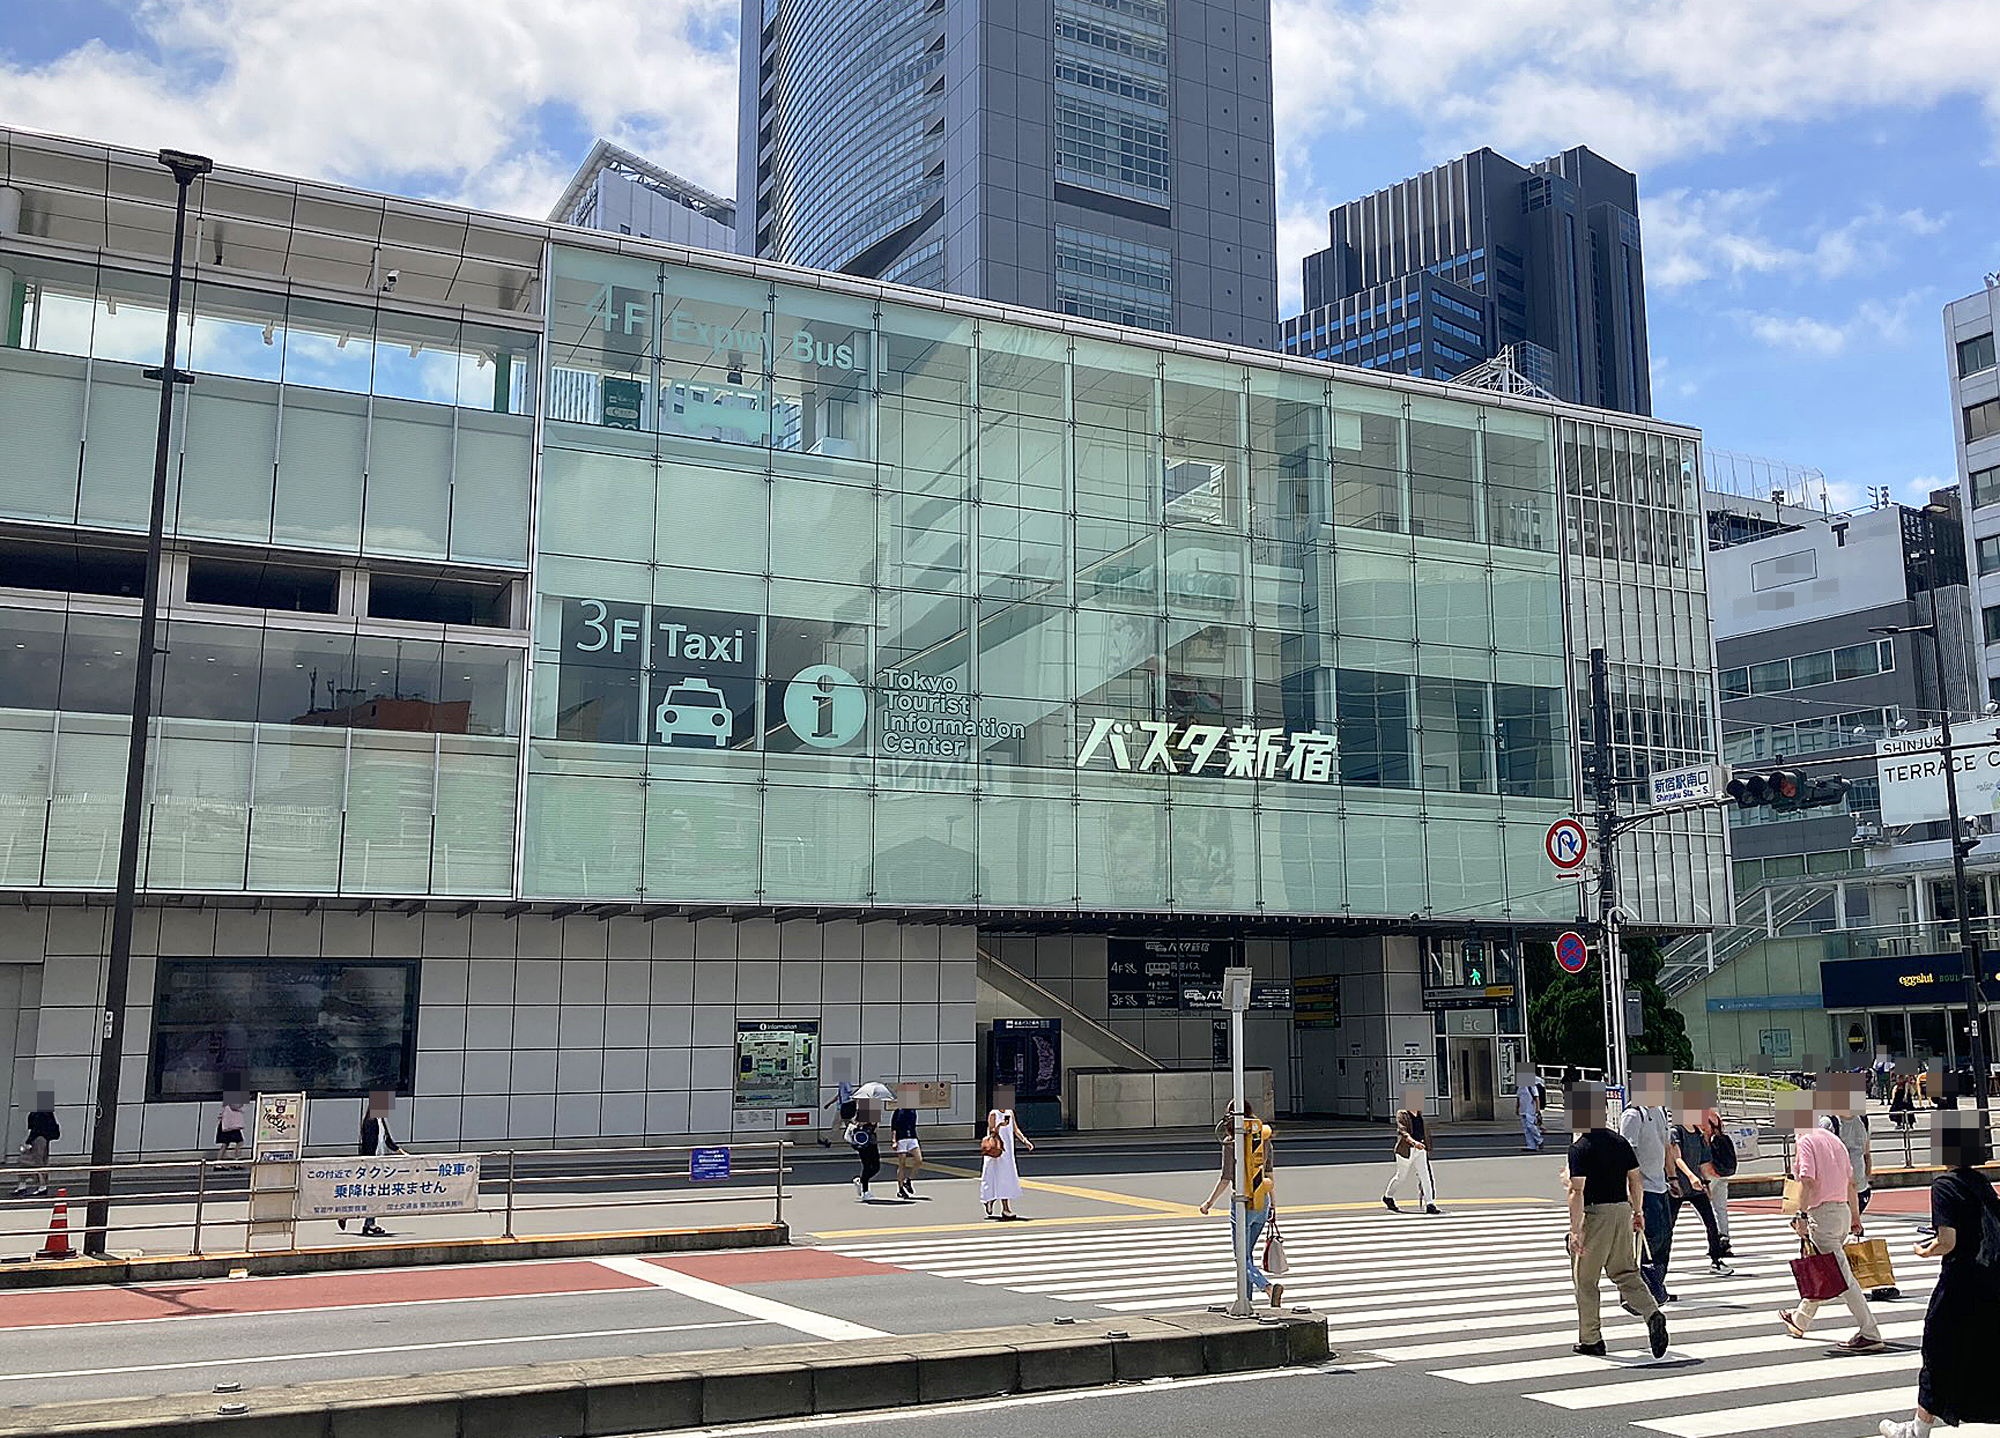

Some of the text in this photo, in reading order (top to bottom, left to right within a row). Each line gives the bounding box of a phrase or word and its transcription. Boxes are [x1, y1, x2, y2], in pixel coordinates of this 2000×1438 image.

[586, 284, 649, 336] 4F
[792, 330, 855, 371] Bus
[575, 599, 743, 664] 3F Taxi
[882, 668, 958, 695] Tokyo
[882, 691, 970, 716] Tourist
[882, 711, 1027, 740] Information
[881, 733, 966, 757] Center
[1076, 717, 1339, 783] バスタ新宿
[1882, 735, 1944, 753] SHINJUK
[1884, 754, 1977, 783] TERRACE
[1654, 770, 1709, 793] 新宿駅南口
[1110, 961, 1124, 974] 4F
[1111, 993, 1124, 1006] 3F
[333, 1180, 448, 1199] 乗降は出来ません
